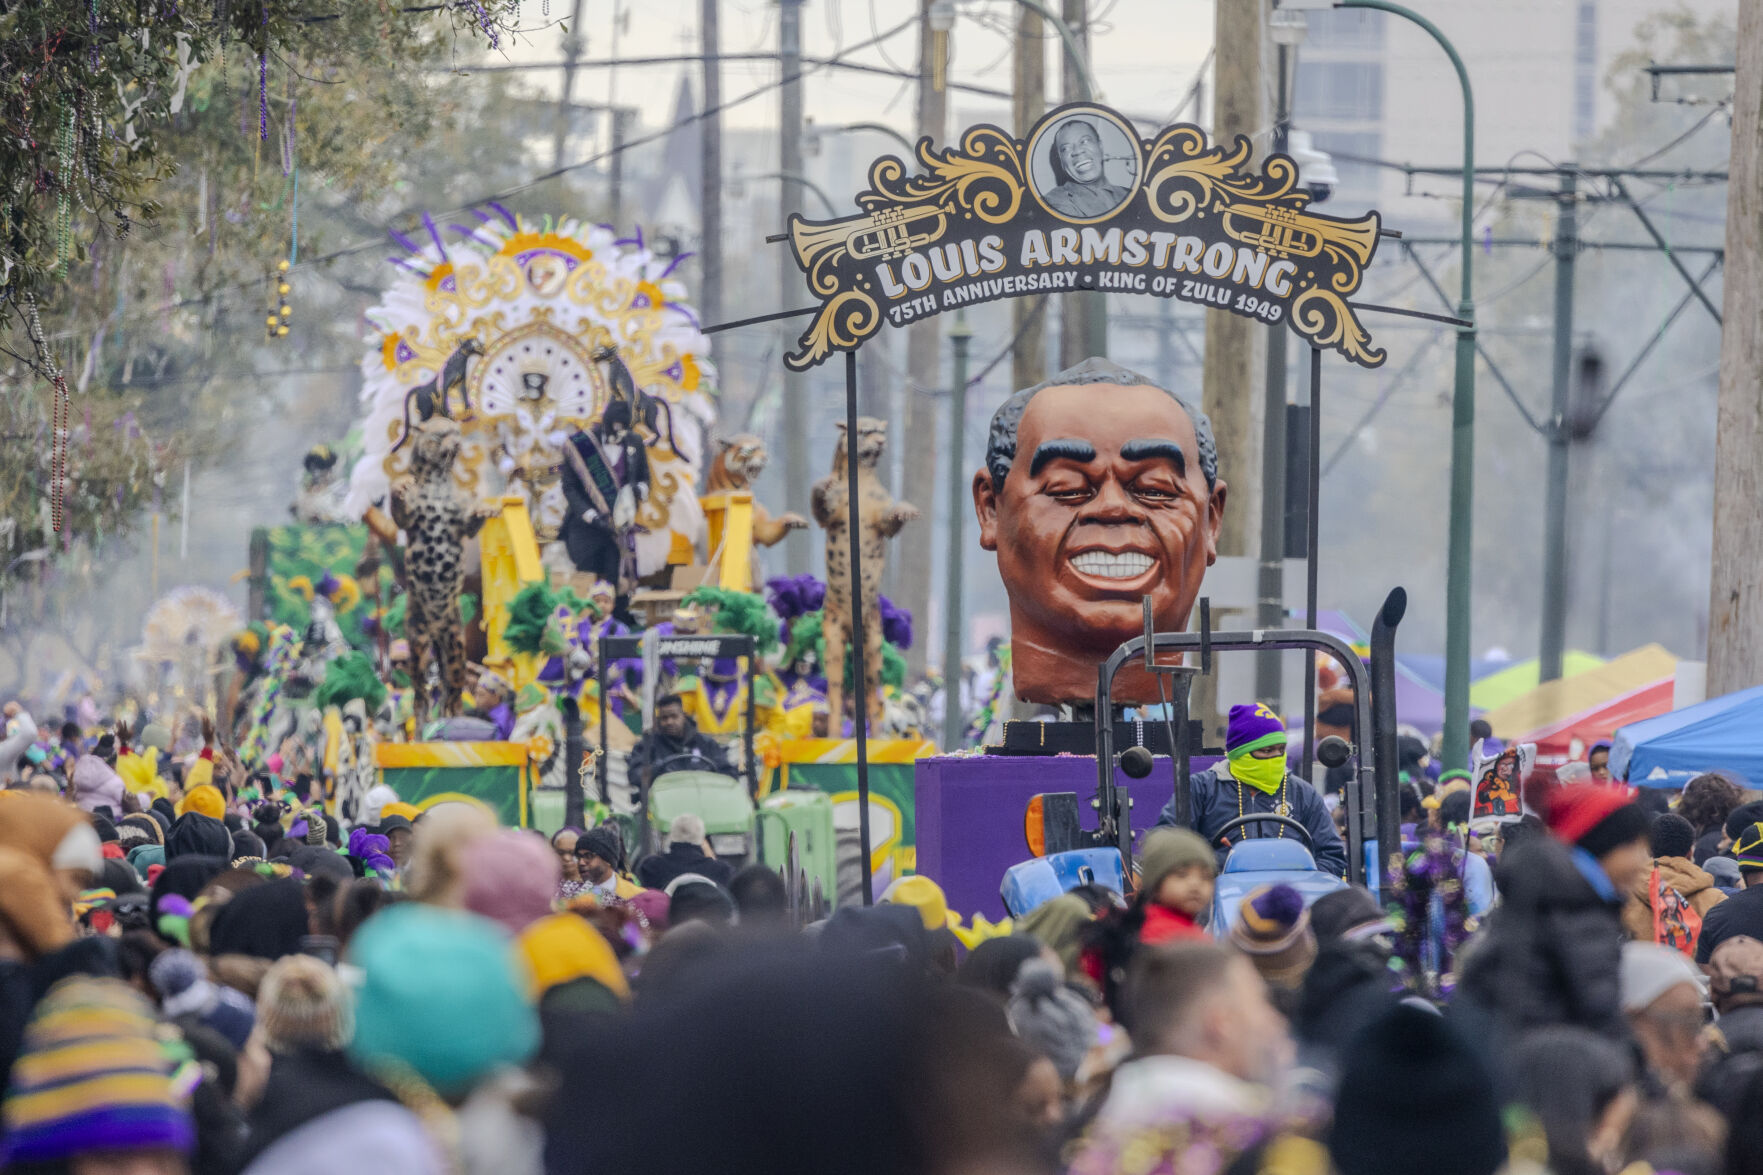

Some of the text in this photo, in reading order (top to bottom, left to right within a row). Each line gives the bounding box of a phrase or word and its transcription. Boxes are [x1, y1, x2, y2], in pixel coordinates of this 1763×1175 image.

[876, 227, 1298, 299] LOUIS ARMSTRONG
[889, 271, 1282, 323] 75TH ANNIVERSARY KING OF ZULU 1949
[656, 640, 721, 656] UNSHINE
